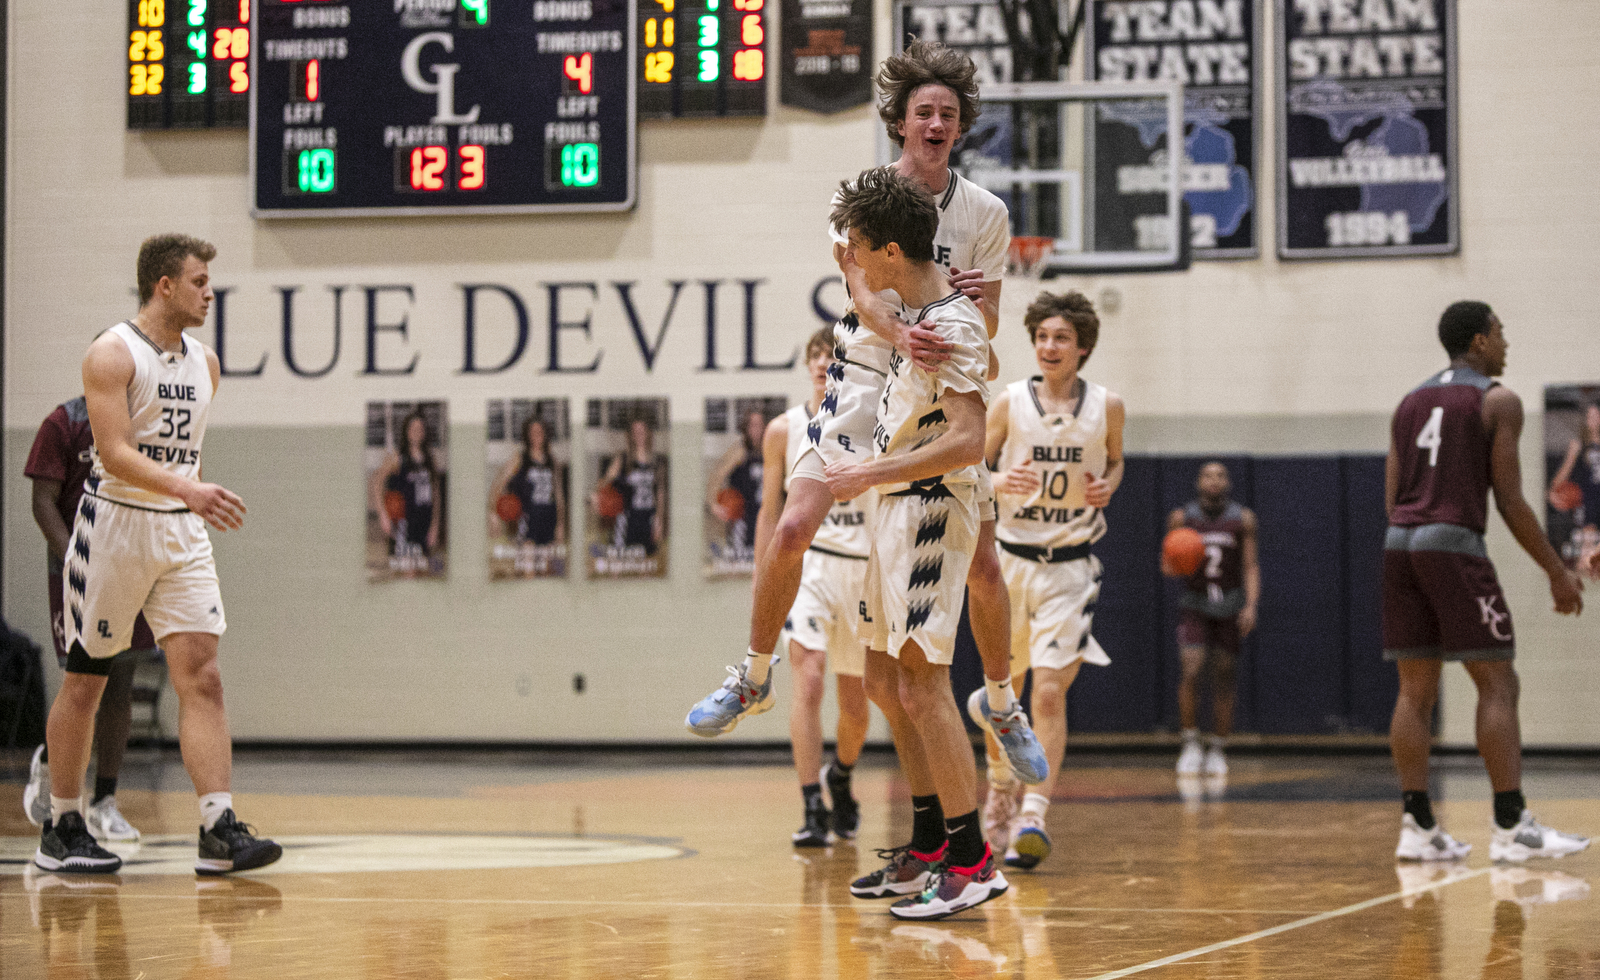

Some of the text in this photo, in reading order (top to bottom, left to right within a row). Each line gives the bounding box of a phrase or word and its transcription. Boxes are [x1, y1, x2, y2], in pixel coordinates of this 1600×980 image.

[138, 0, 165, 27] 10
[187, 0, 207, 26] 2
[293, 6, 350, 28] BONUS
[533, 1, 592, 21] BONUS
[1104, 0, 1246, 42] TEAM
[1297, 0, 1437, 34] TEAM
[129, 30, 164, 61] 25
[187, 29, 207, 59] 4
[212, 27, 250, 60] 28
[537, 31, 622, 53] TIMEOUTS
[645, 17, 674, 48] 11
[697, 14, 719, 47] 3
[741, 14, 764, 46] 6
[264, 37, 349, 60] TIMEOUTS
[1289, 36, 1445, 80] STATE
[129, 63, 164, 95] 32
[187, 62, 207, 94] 3
[229, 61, 250, 93] 5
[306, 58, 319, 102] 1
[401, 31, 481, 126] GL
[564, 52, 592, 94] 4
[645, 51, 674, 83] 12
[697, 49, 719, 82] 3
[1100, 43, 1250, 87] STATE
[283, 102, 325, 124] LEFT
[557, 96, 600, 118] LEFT
[283, 127, 338, 150] FOULS
[384, 123, 514, 147] PLAYER FOULS
[545, 122, 600, 144] FOULS
[298, 148, 335, 192] 10
[410, 145, 448, 191] 12
[458, 144, 485, 190] 3
[561, 143, 599, 187] 10
[1289, 154, 1446, 189] VOLLEYBALL
[1325, 210, 1412, 247] 1994
[131, 284, 422, 379] LUE
[158, 383, 197, 401] BLUE
[159, 408, 191, 441] 32
[1416, 406, 1444, 467] 4
[137, 443, 200, 466] DEVILS
[1033, 446, 1083, 463] BLUE
[1041, 470, 1068, 500] 10
[824, 511, 865, 526] VILS
[1477, 596, 1511, 641] KC
